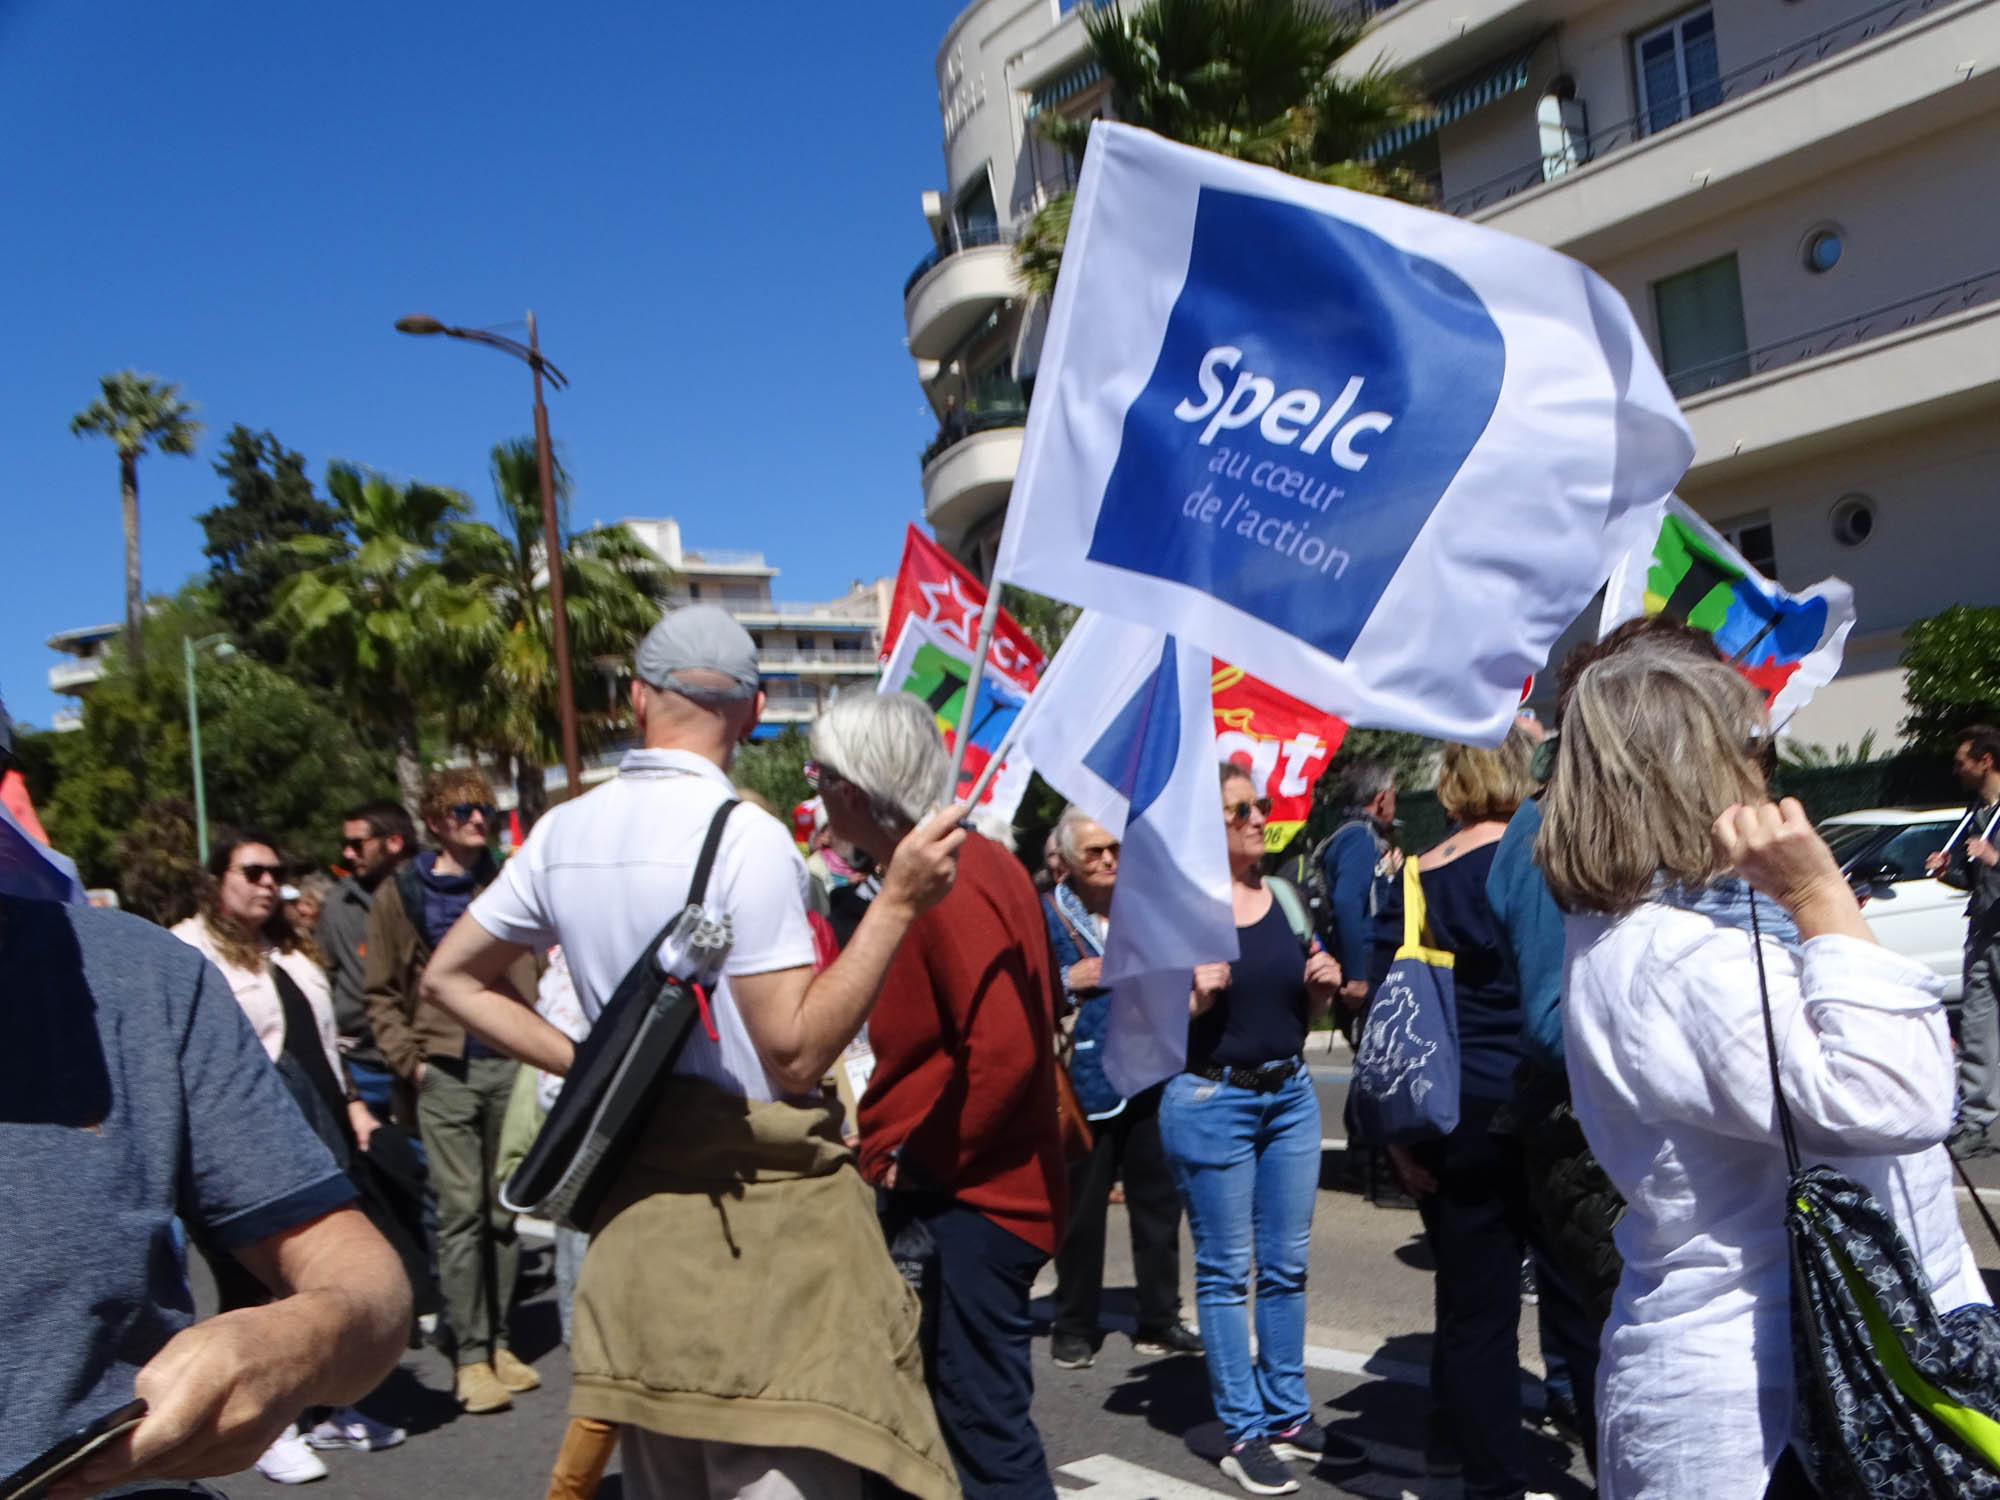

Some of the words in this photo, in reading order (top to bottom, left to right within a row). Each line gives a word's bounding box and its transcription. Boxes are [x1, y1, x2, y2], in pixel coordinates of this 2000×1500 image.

[1174, 345, 1393, 472] Spelc
[1208, 447, 1250, 480] au
[1251, 461, 1345, 512] cœur
[1182, 482, 1222, 523] de
[1221, 493, 1351, 581] l'action
